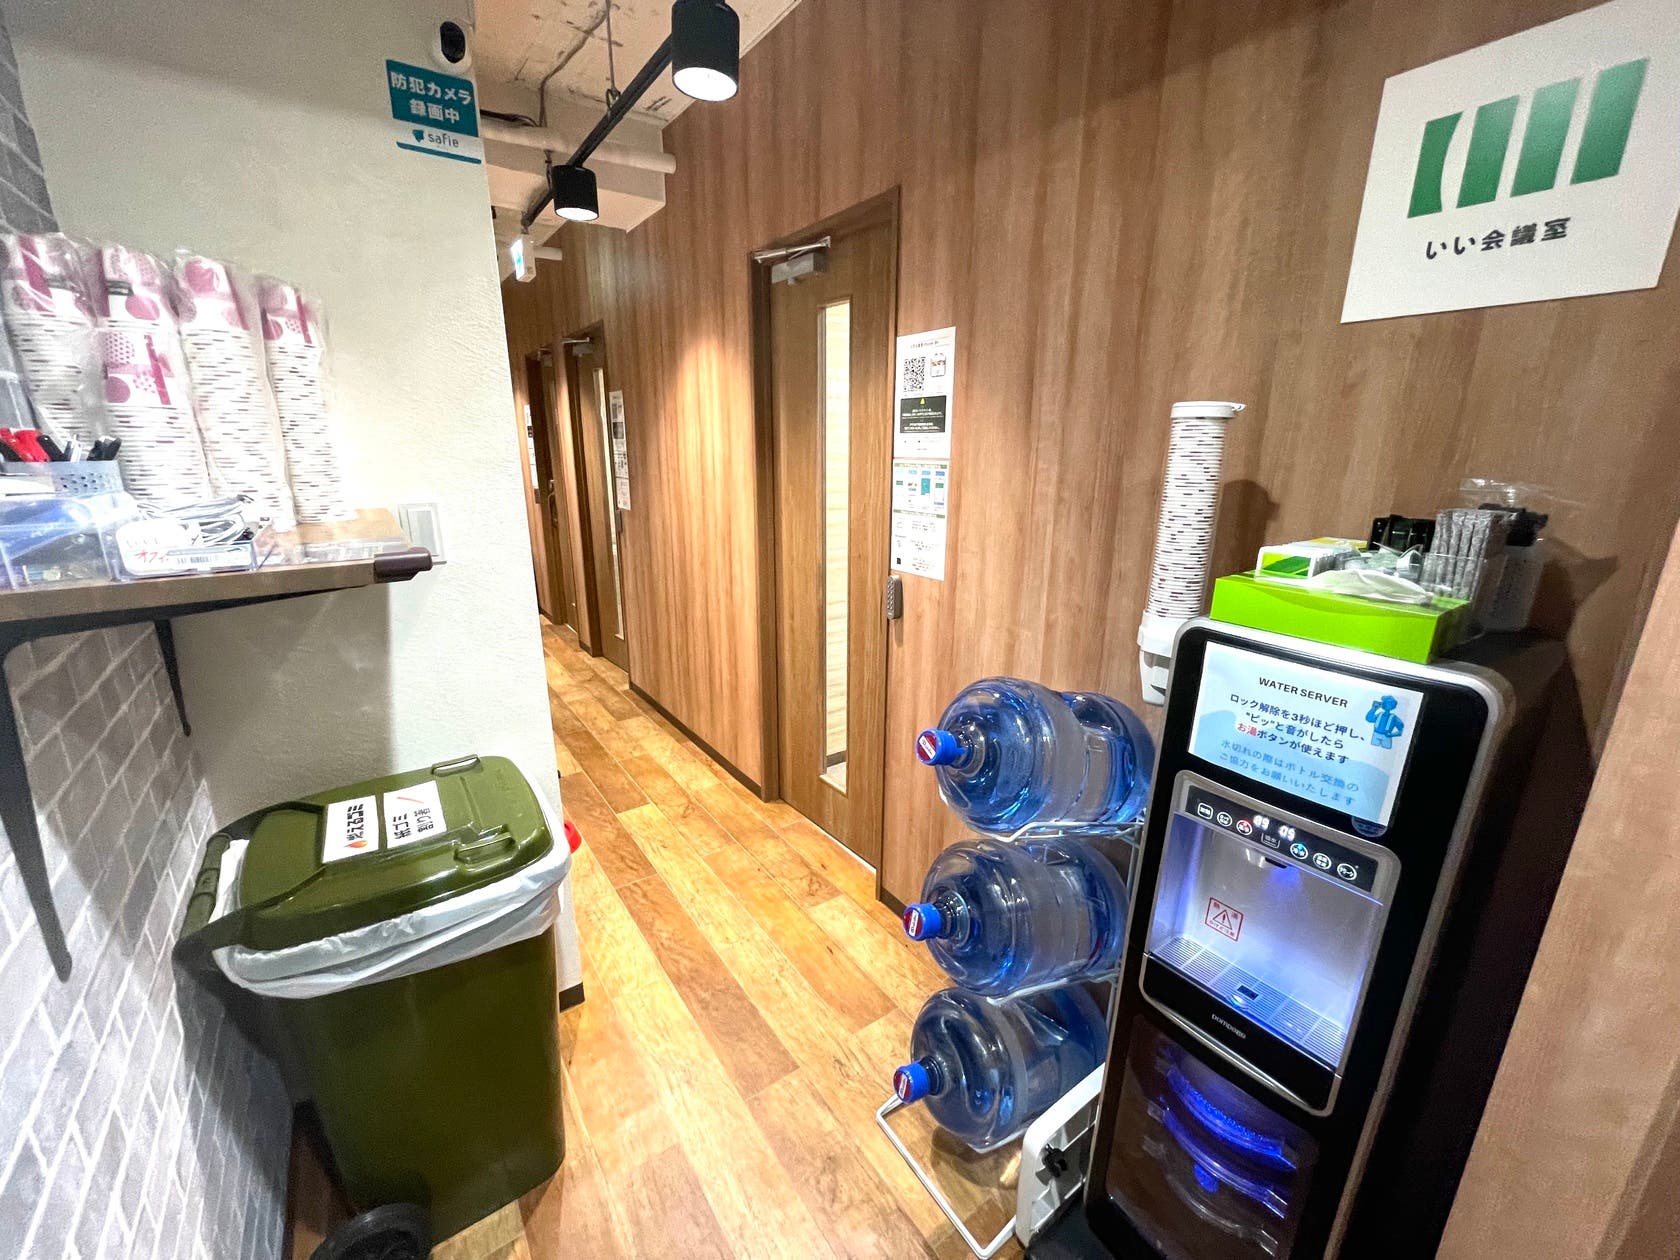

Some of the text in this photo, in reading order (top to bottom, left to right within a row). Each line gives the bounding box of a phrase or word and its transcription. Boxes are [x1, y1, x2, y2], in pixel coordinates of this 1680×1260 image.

[391, 71, 472, 105] 防犯カメラ
[410, 98, 460, 124] 録画中
[1426, 217, 1571, 260] いい会議室
[1259, 677, 1348, 708] WATER SERVER
